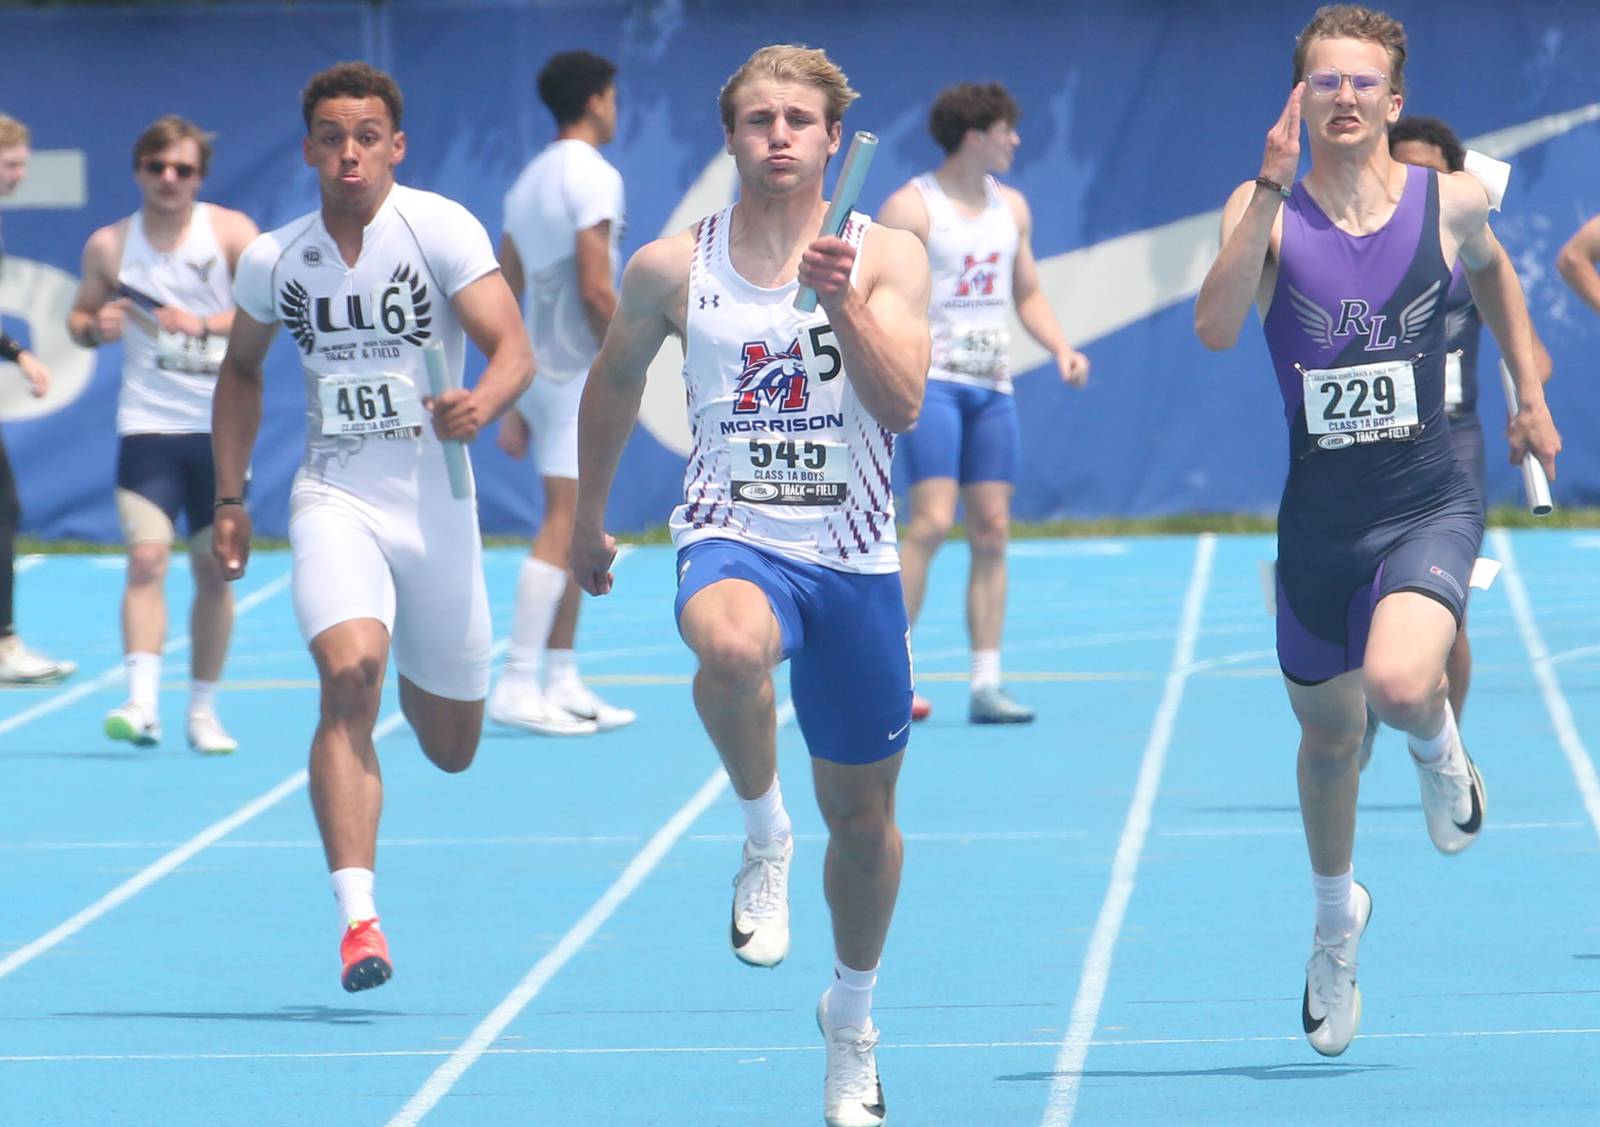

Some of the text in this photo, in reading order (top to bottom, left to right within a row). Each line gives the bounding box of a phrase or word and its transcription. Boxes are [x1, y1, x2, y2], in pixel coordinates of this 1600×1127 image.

[381, 286, 406, 334] 6
[325, 350, 356, 361] TRACK
[372, 346, 400, 358] FIELD
[808, 324, 842, 382] 5
[337, 383, 398, 421] 461
[1320, 375, 1397, 421] 229
[379, 418, 401, 429] BOYS
[720, 413, 844, 435] MORRISON
[1328, 416, 1396, 432] CLASS 1A BOYS
[1355, 430, 1380, 443] TRACK
[1388, 426, 1410, 439] FIELD
[749, 438, 827, 469] 545
[753, 469, 825, 481] CLASS 1A BOYS
[780, 484, 806, 496] TRACK
[815, 484, 838, 496] FIELD
